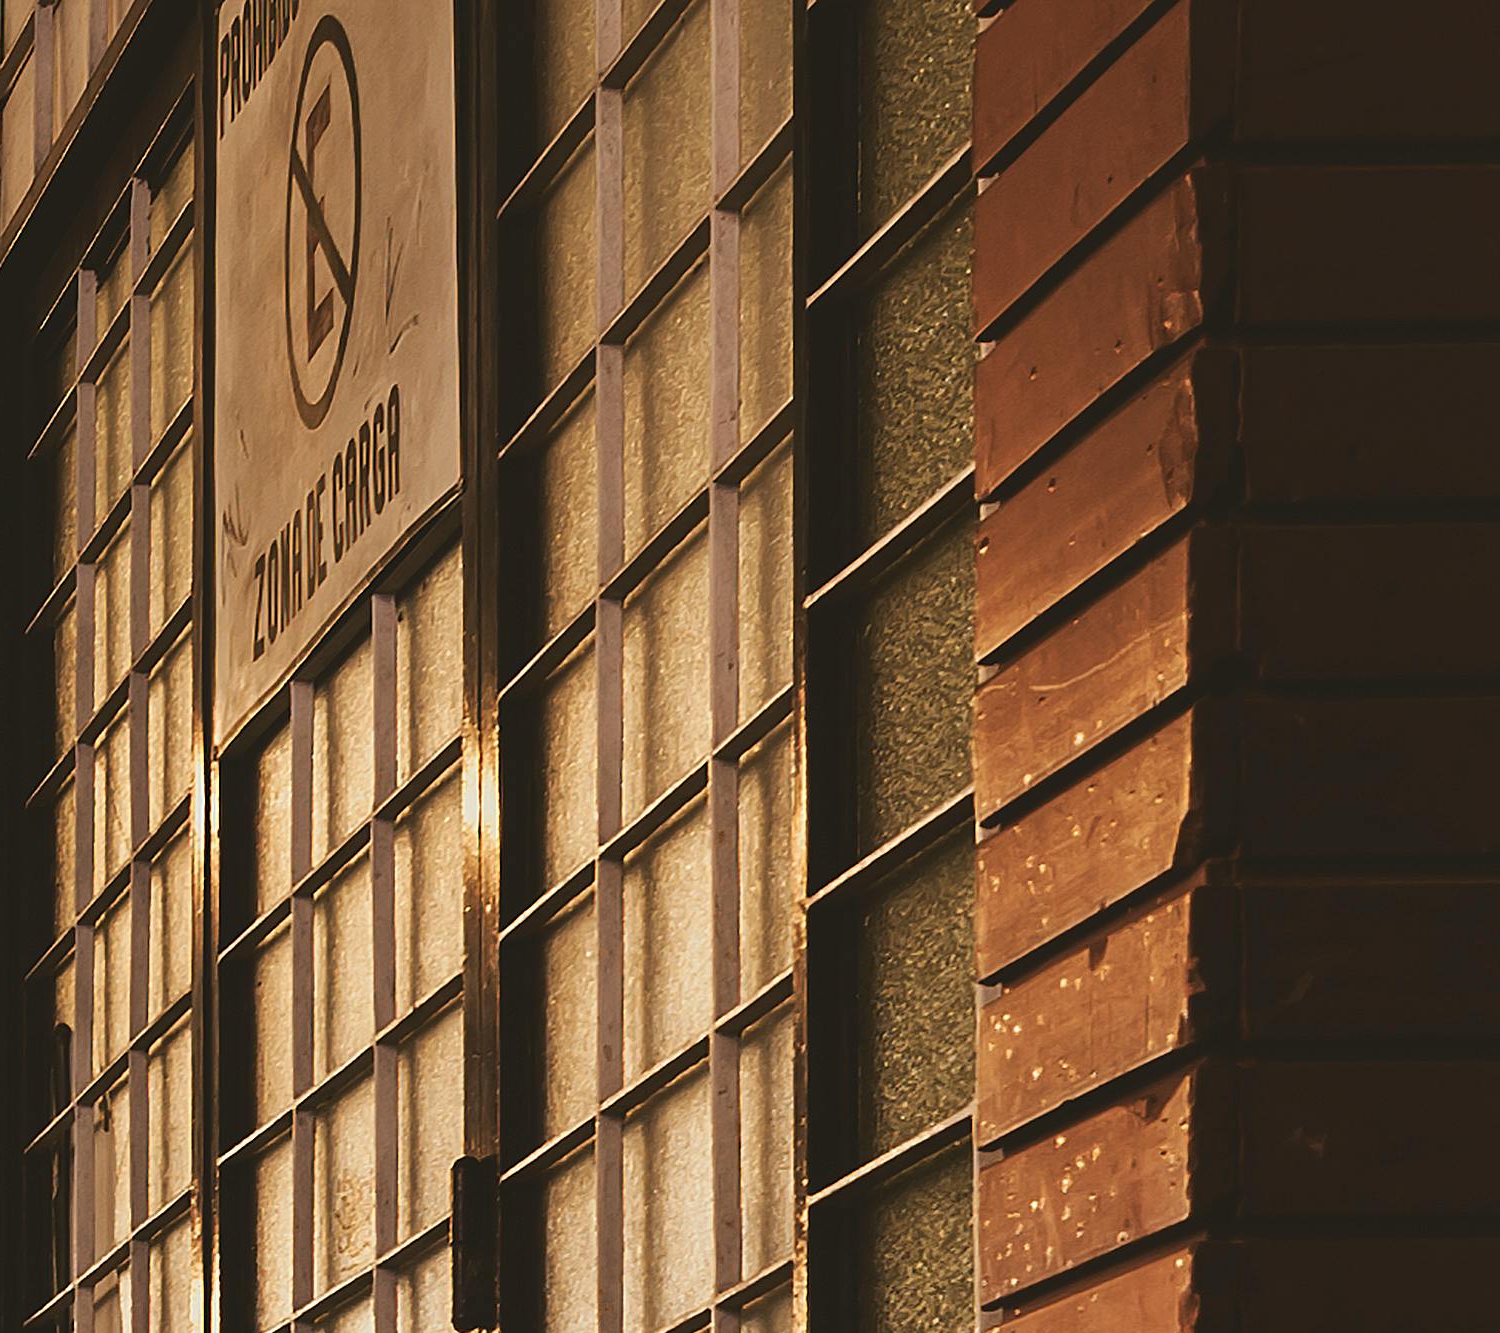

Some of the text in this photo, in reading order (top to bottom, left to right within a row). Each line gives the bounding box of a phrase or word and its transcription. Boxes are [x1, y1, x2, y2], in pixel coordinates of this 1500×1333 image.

[253, 383, 400, 662] ZONA DE CARGA
